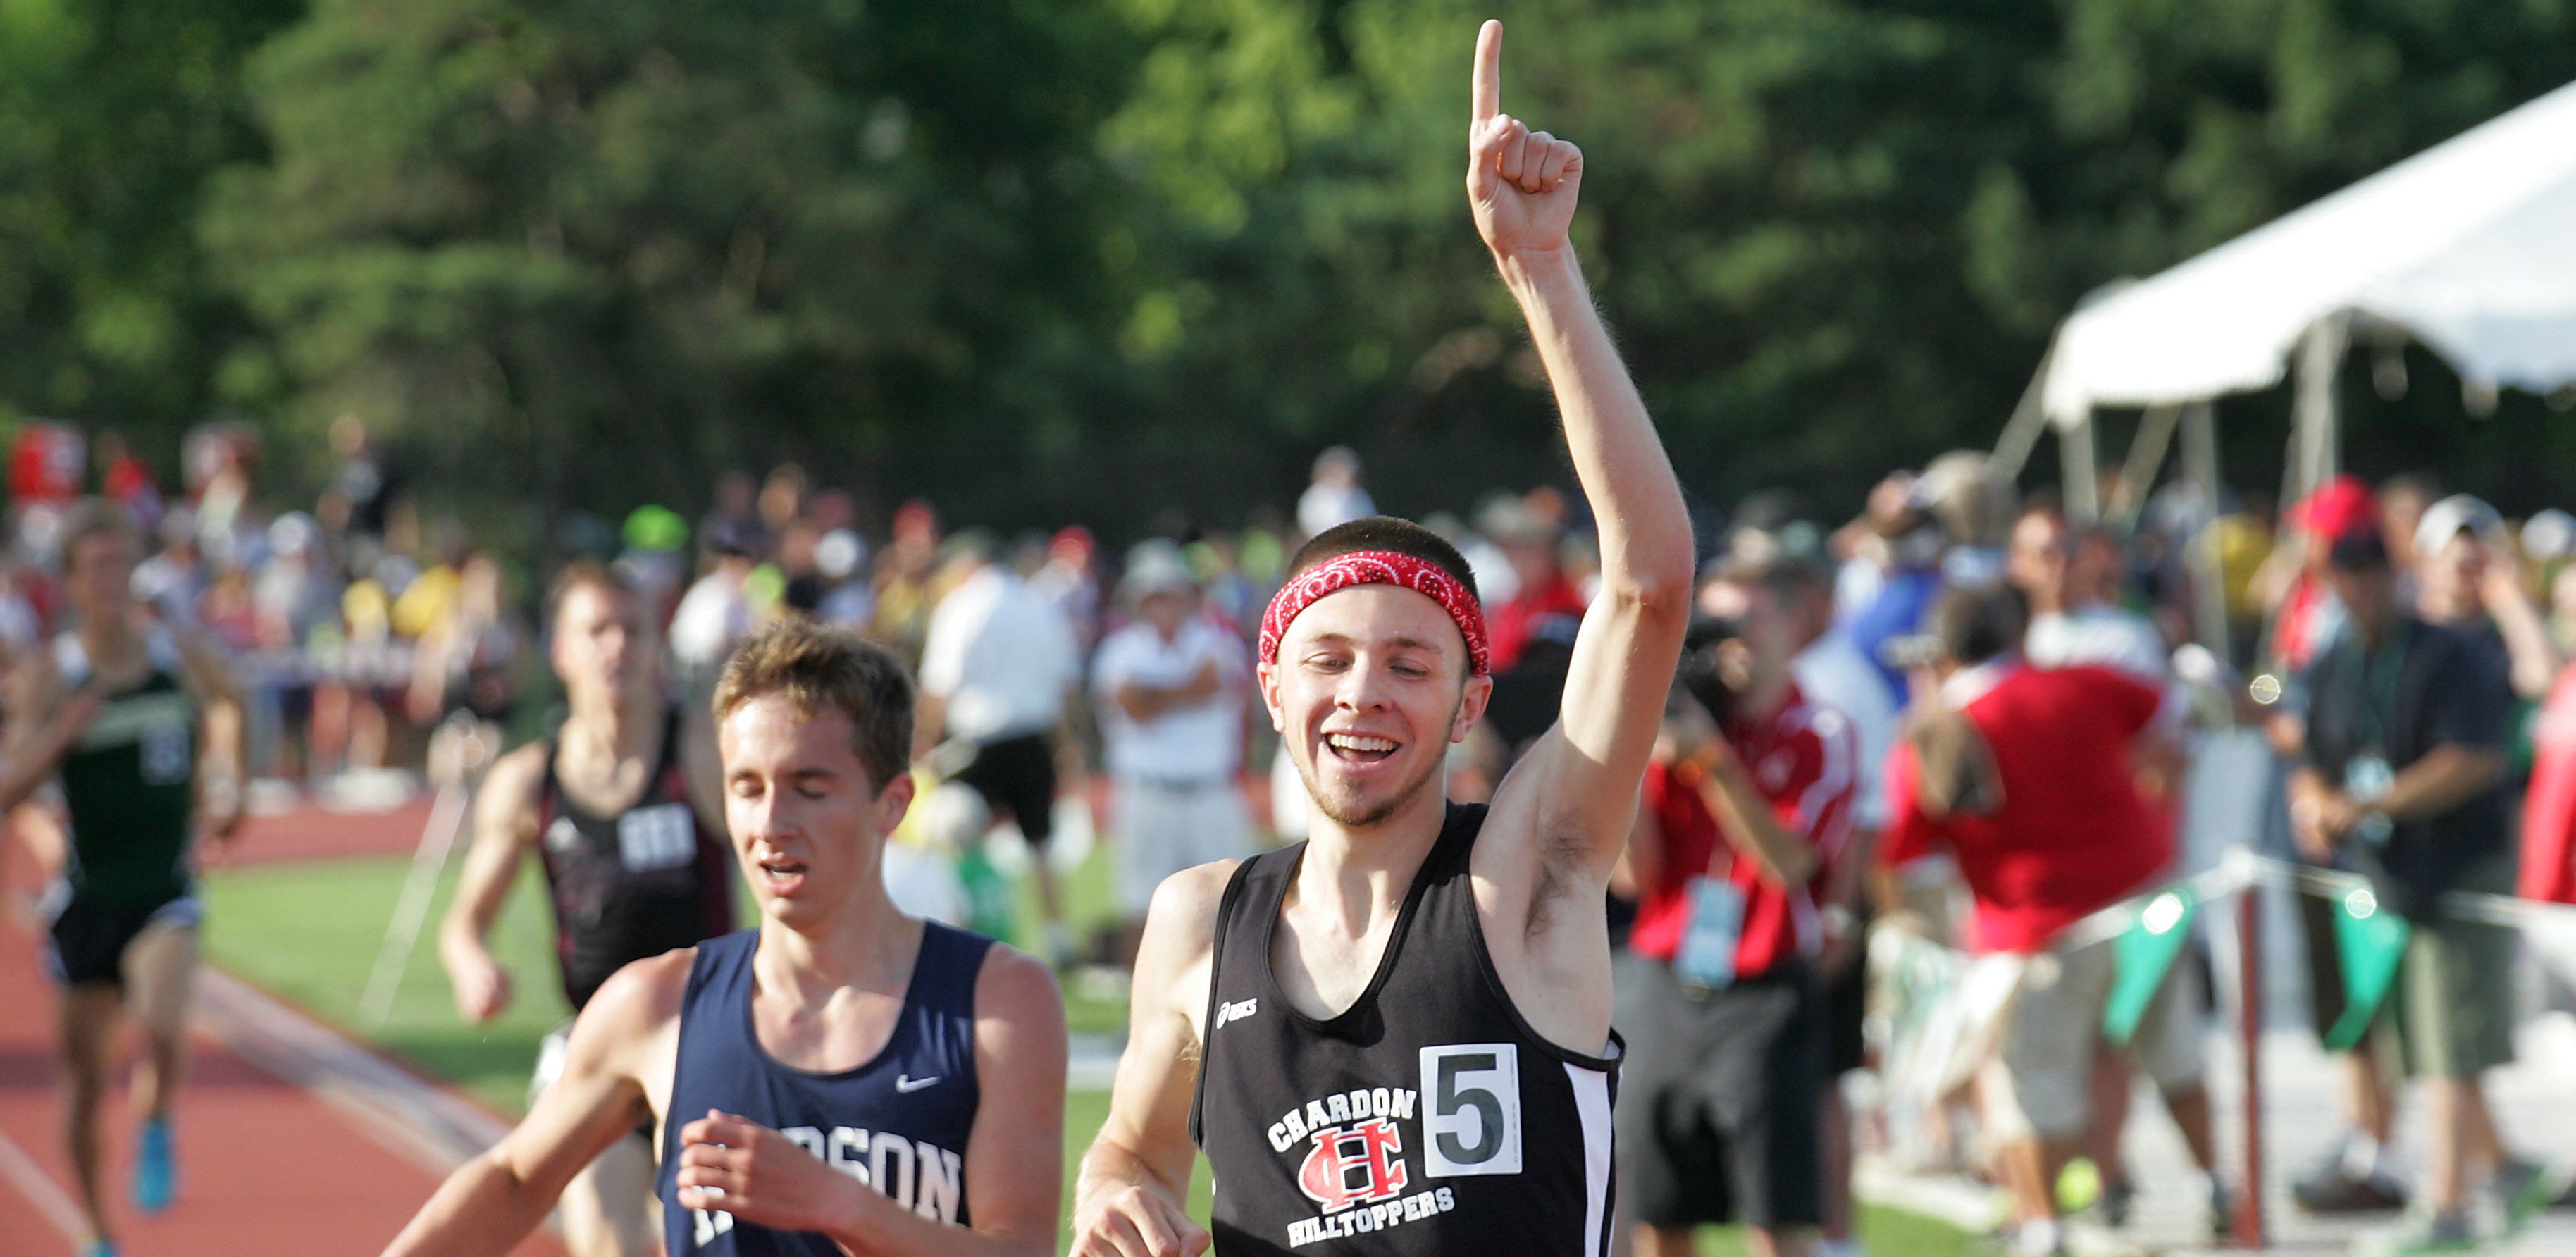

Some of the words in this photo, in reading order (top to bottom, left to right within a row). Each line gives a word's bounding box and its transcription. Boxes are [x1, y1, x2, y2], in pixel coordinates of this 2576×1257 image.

[1268, 1087, 1417, 1153] CHARDON
[1436, 1053, 1504, 1165] 5
[1287, 1187, 1455, 1248] HILLTOPPERS
